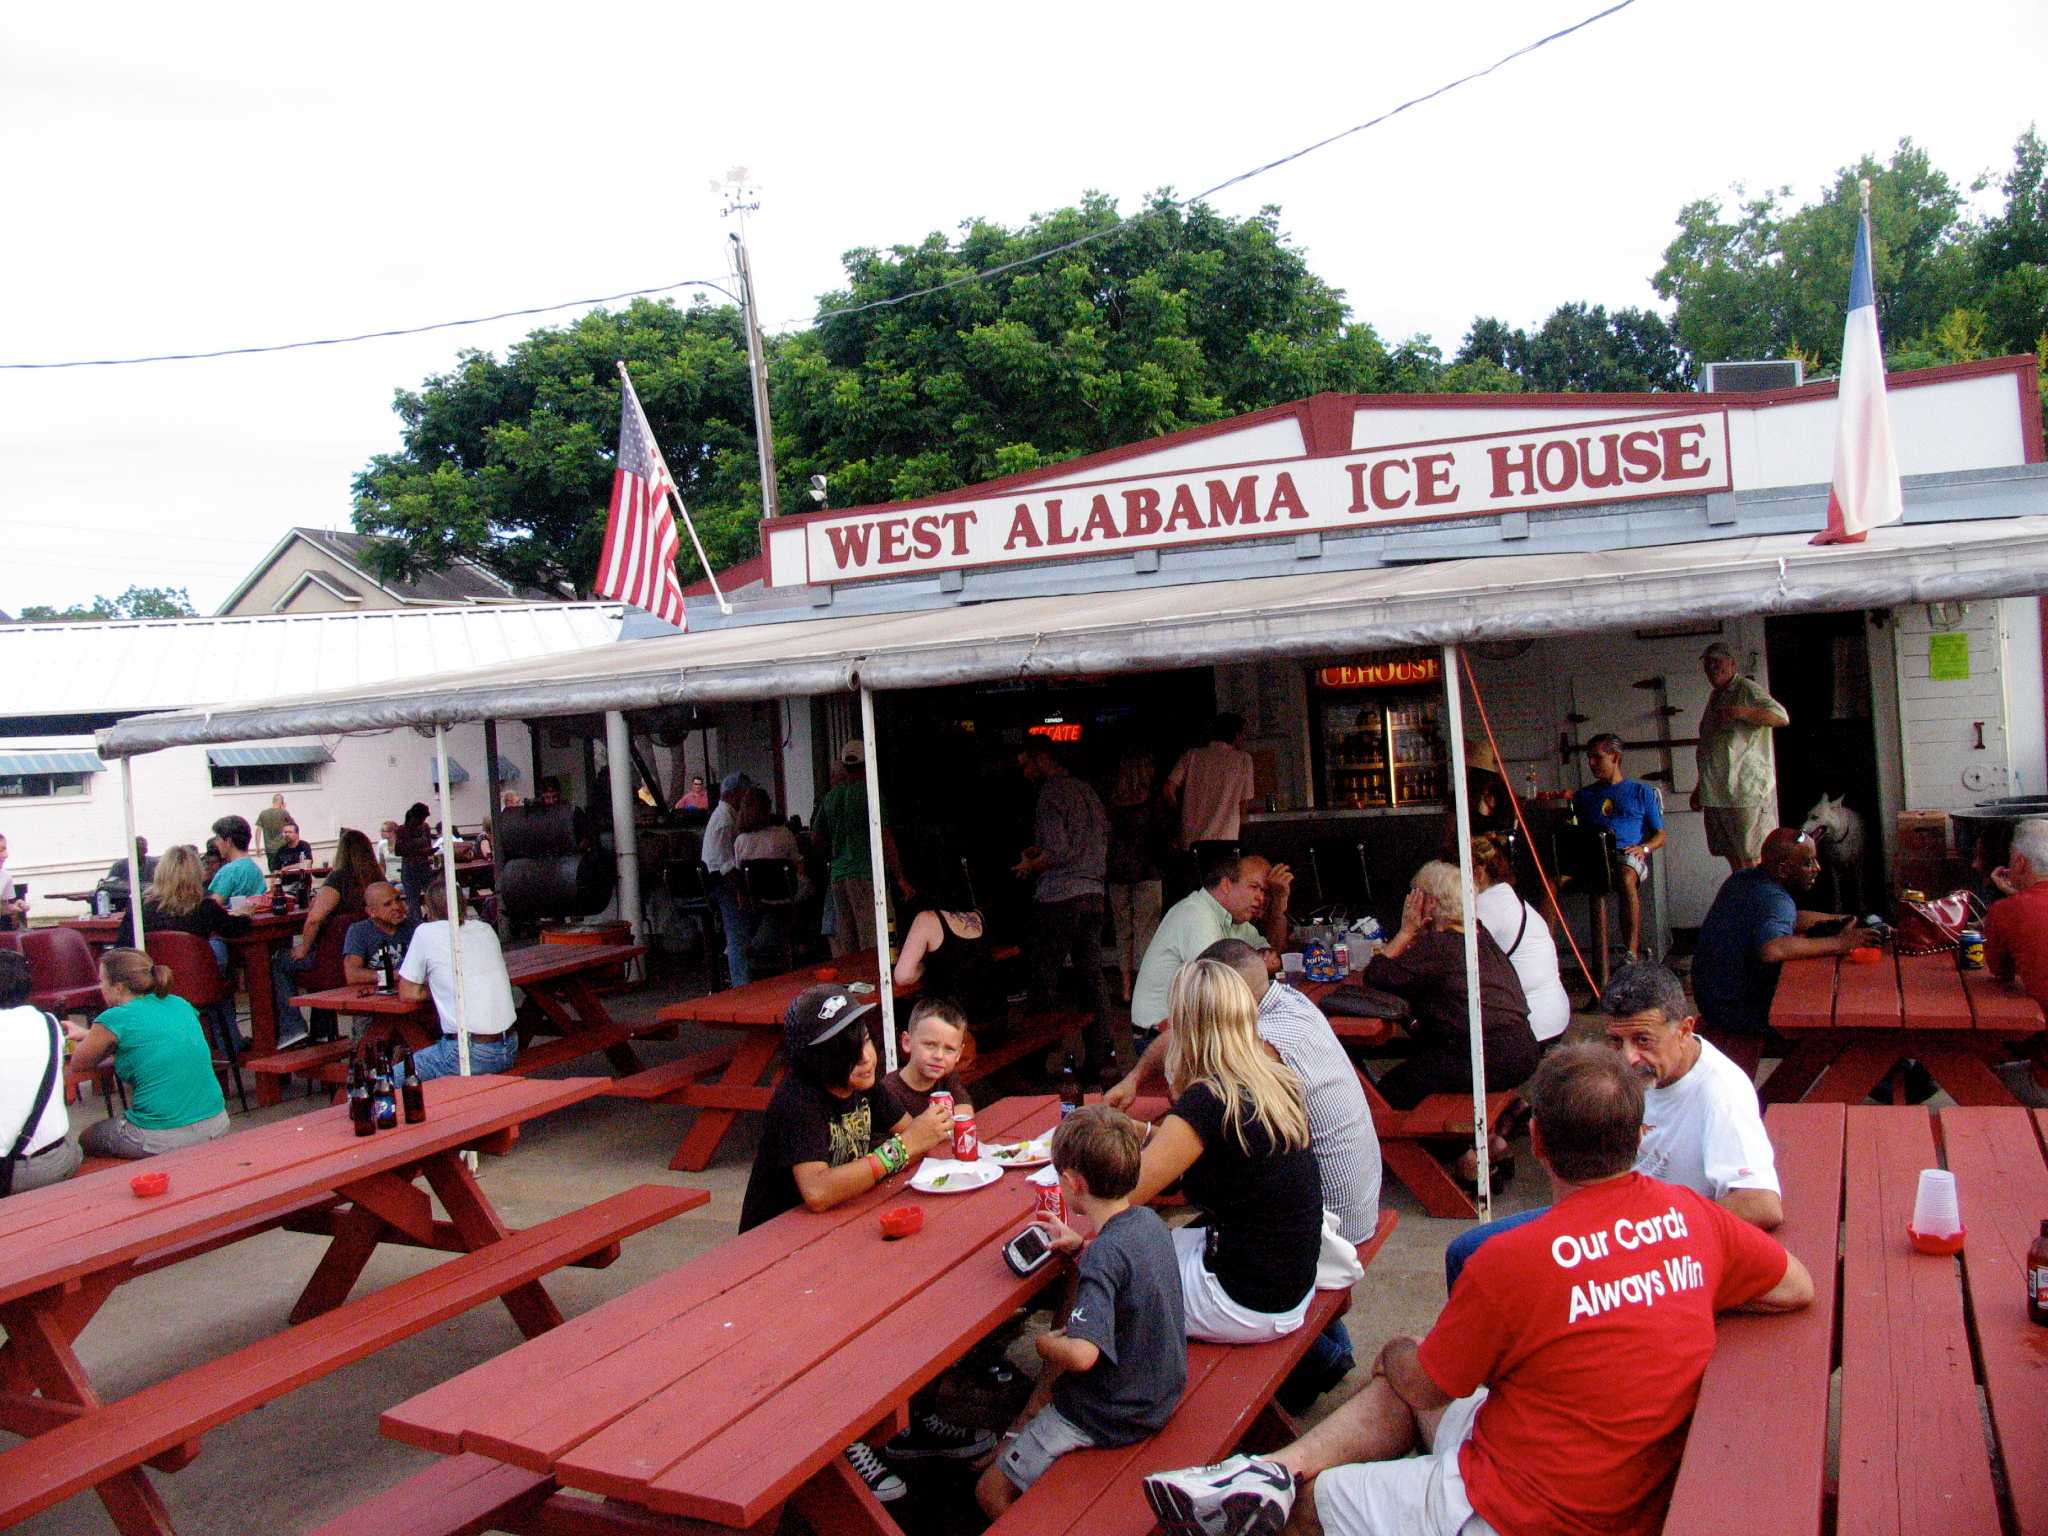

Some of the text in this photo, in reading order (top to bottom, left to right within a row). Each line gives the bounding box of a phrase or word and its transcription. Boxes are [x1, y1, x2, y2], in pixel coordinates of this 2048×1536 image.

[828, 424, 1711, 570] WEST ALABAMA ICE HOUSE
[1551, 1206, 1689, 1268] Our Cards
[1568, 1255, 1704, 1324] Always Win
